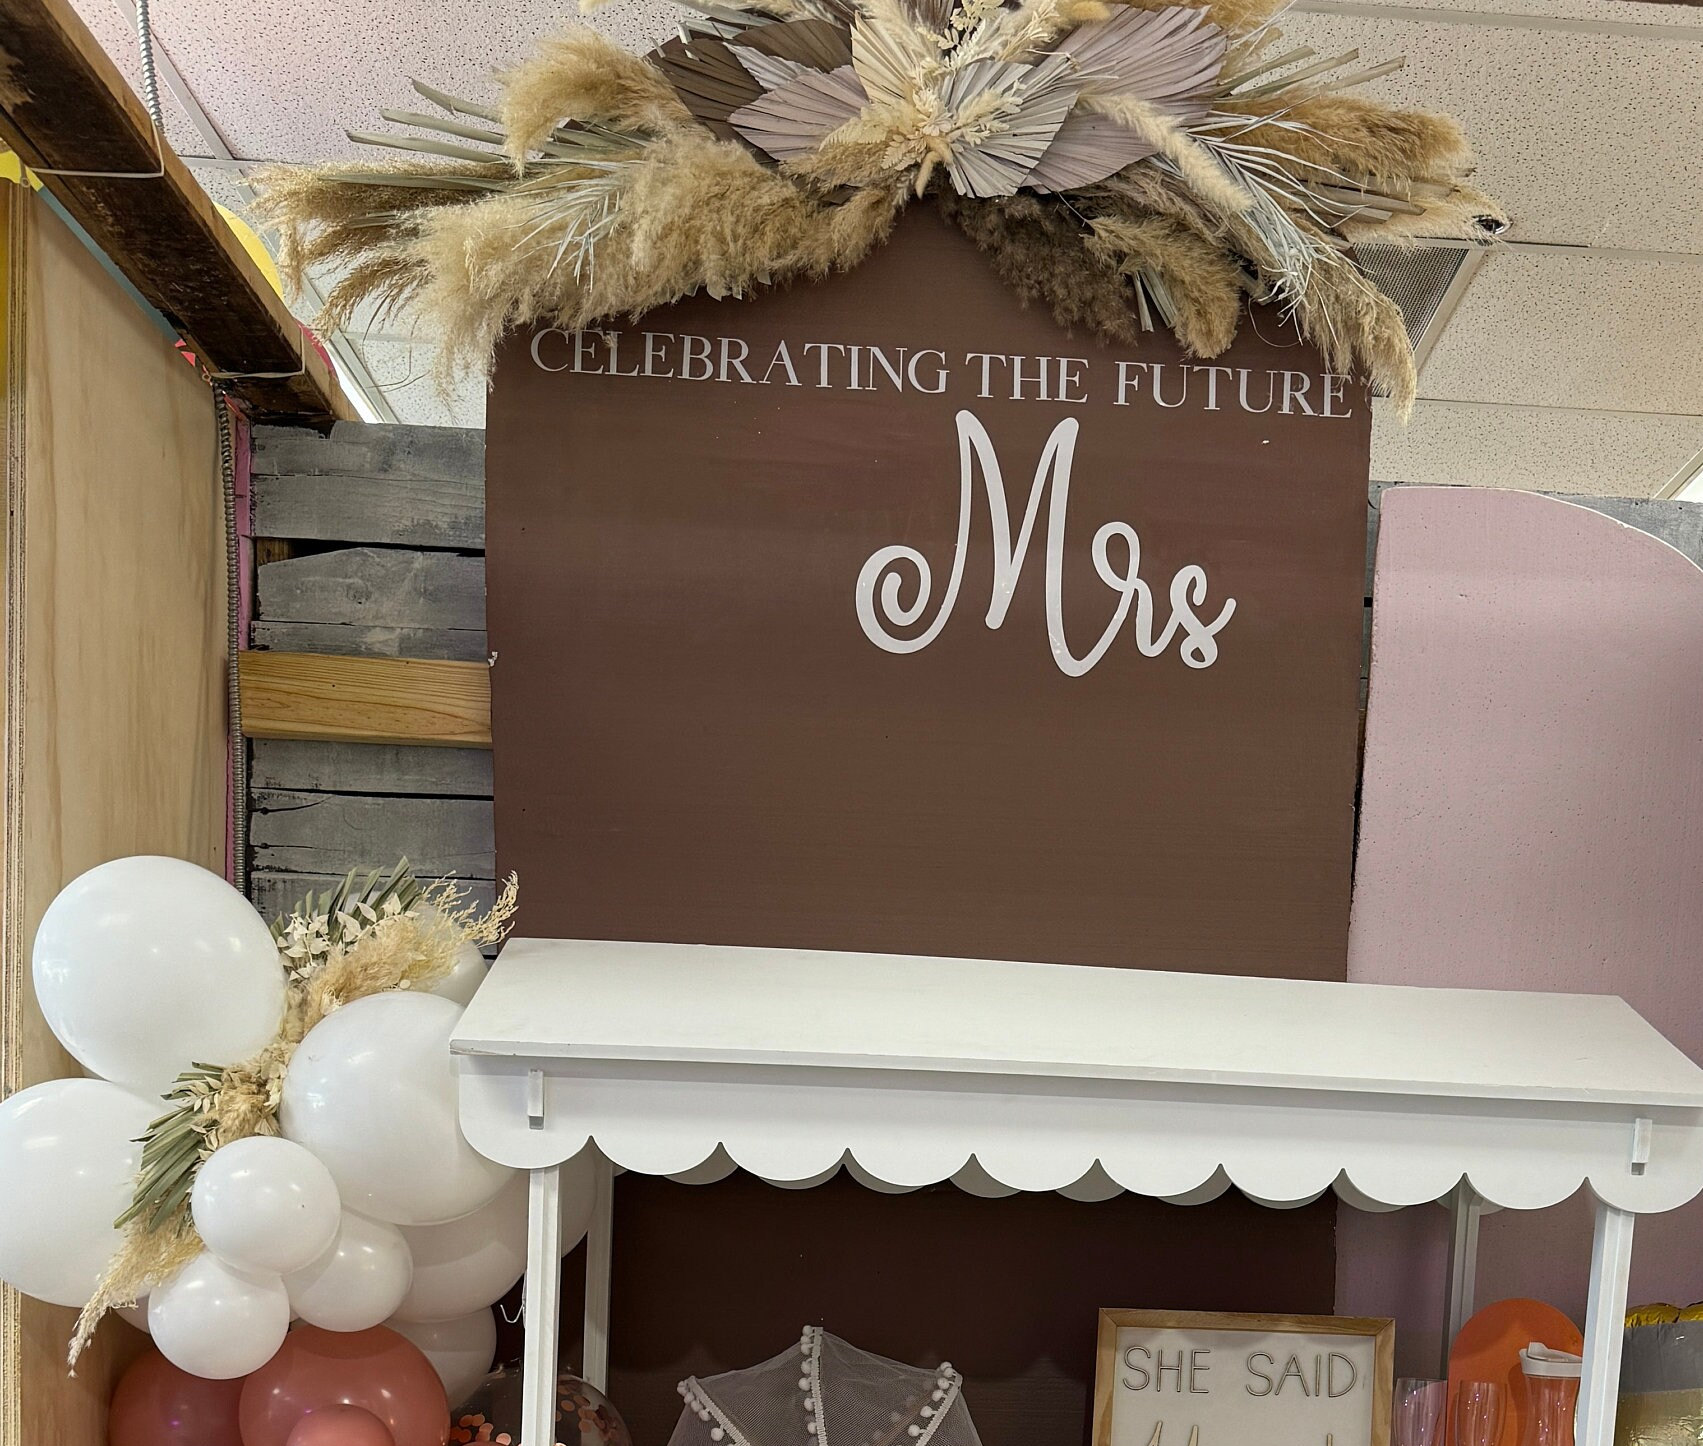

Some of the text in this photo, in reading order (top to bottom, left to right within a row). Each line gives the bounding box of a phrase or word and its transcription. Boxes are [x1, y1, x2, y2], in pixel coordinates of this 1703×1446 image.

[530, 327, 1353, 419] CELEBRATING THE FUTURE
[856, 409, 1237, 677] Mrs
[1123, 1346, 1358, 1398] SHE SAID
